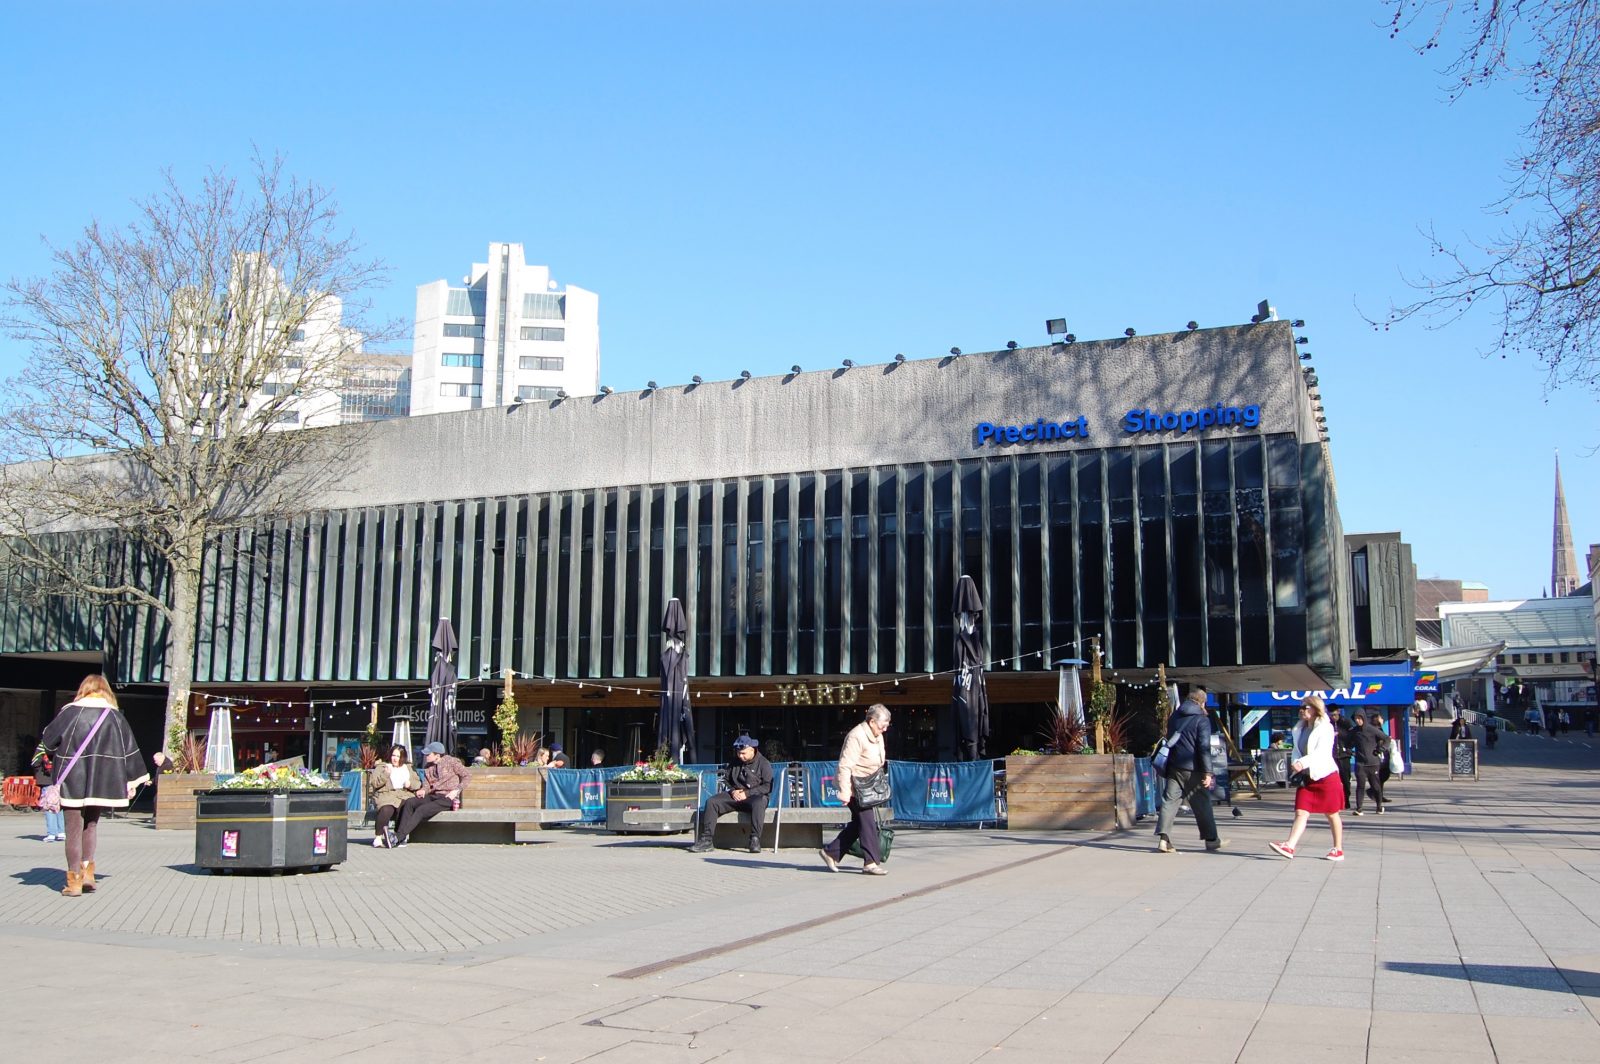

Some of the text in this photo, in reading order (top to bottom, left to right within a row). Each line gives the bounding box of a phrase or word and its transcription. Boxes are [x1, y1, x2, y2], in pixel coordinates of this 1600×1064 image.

[977, 402, 1260, 445] Precinct Shopping
[776, 682, 858, 705] YARD
[409, 705, 430, 722] Esca
[457, 710, 485, 722] ames
[827, 789, 839, 798] yar
[931, 790, 948, 799] yard
